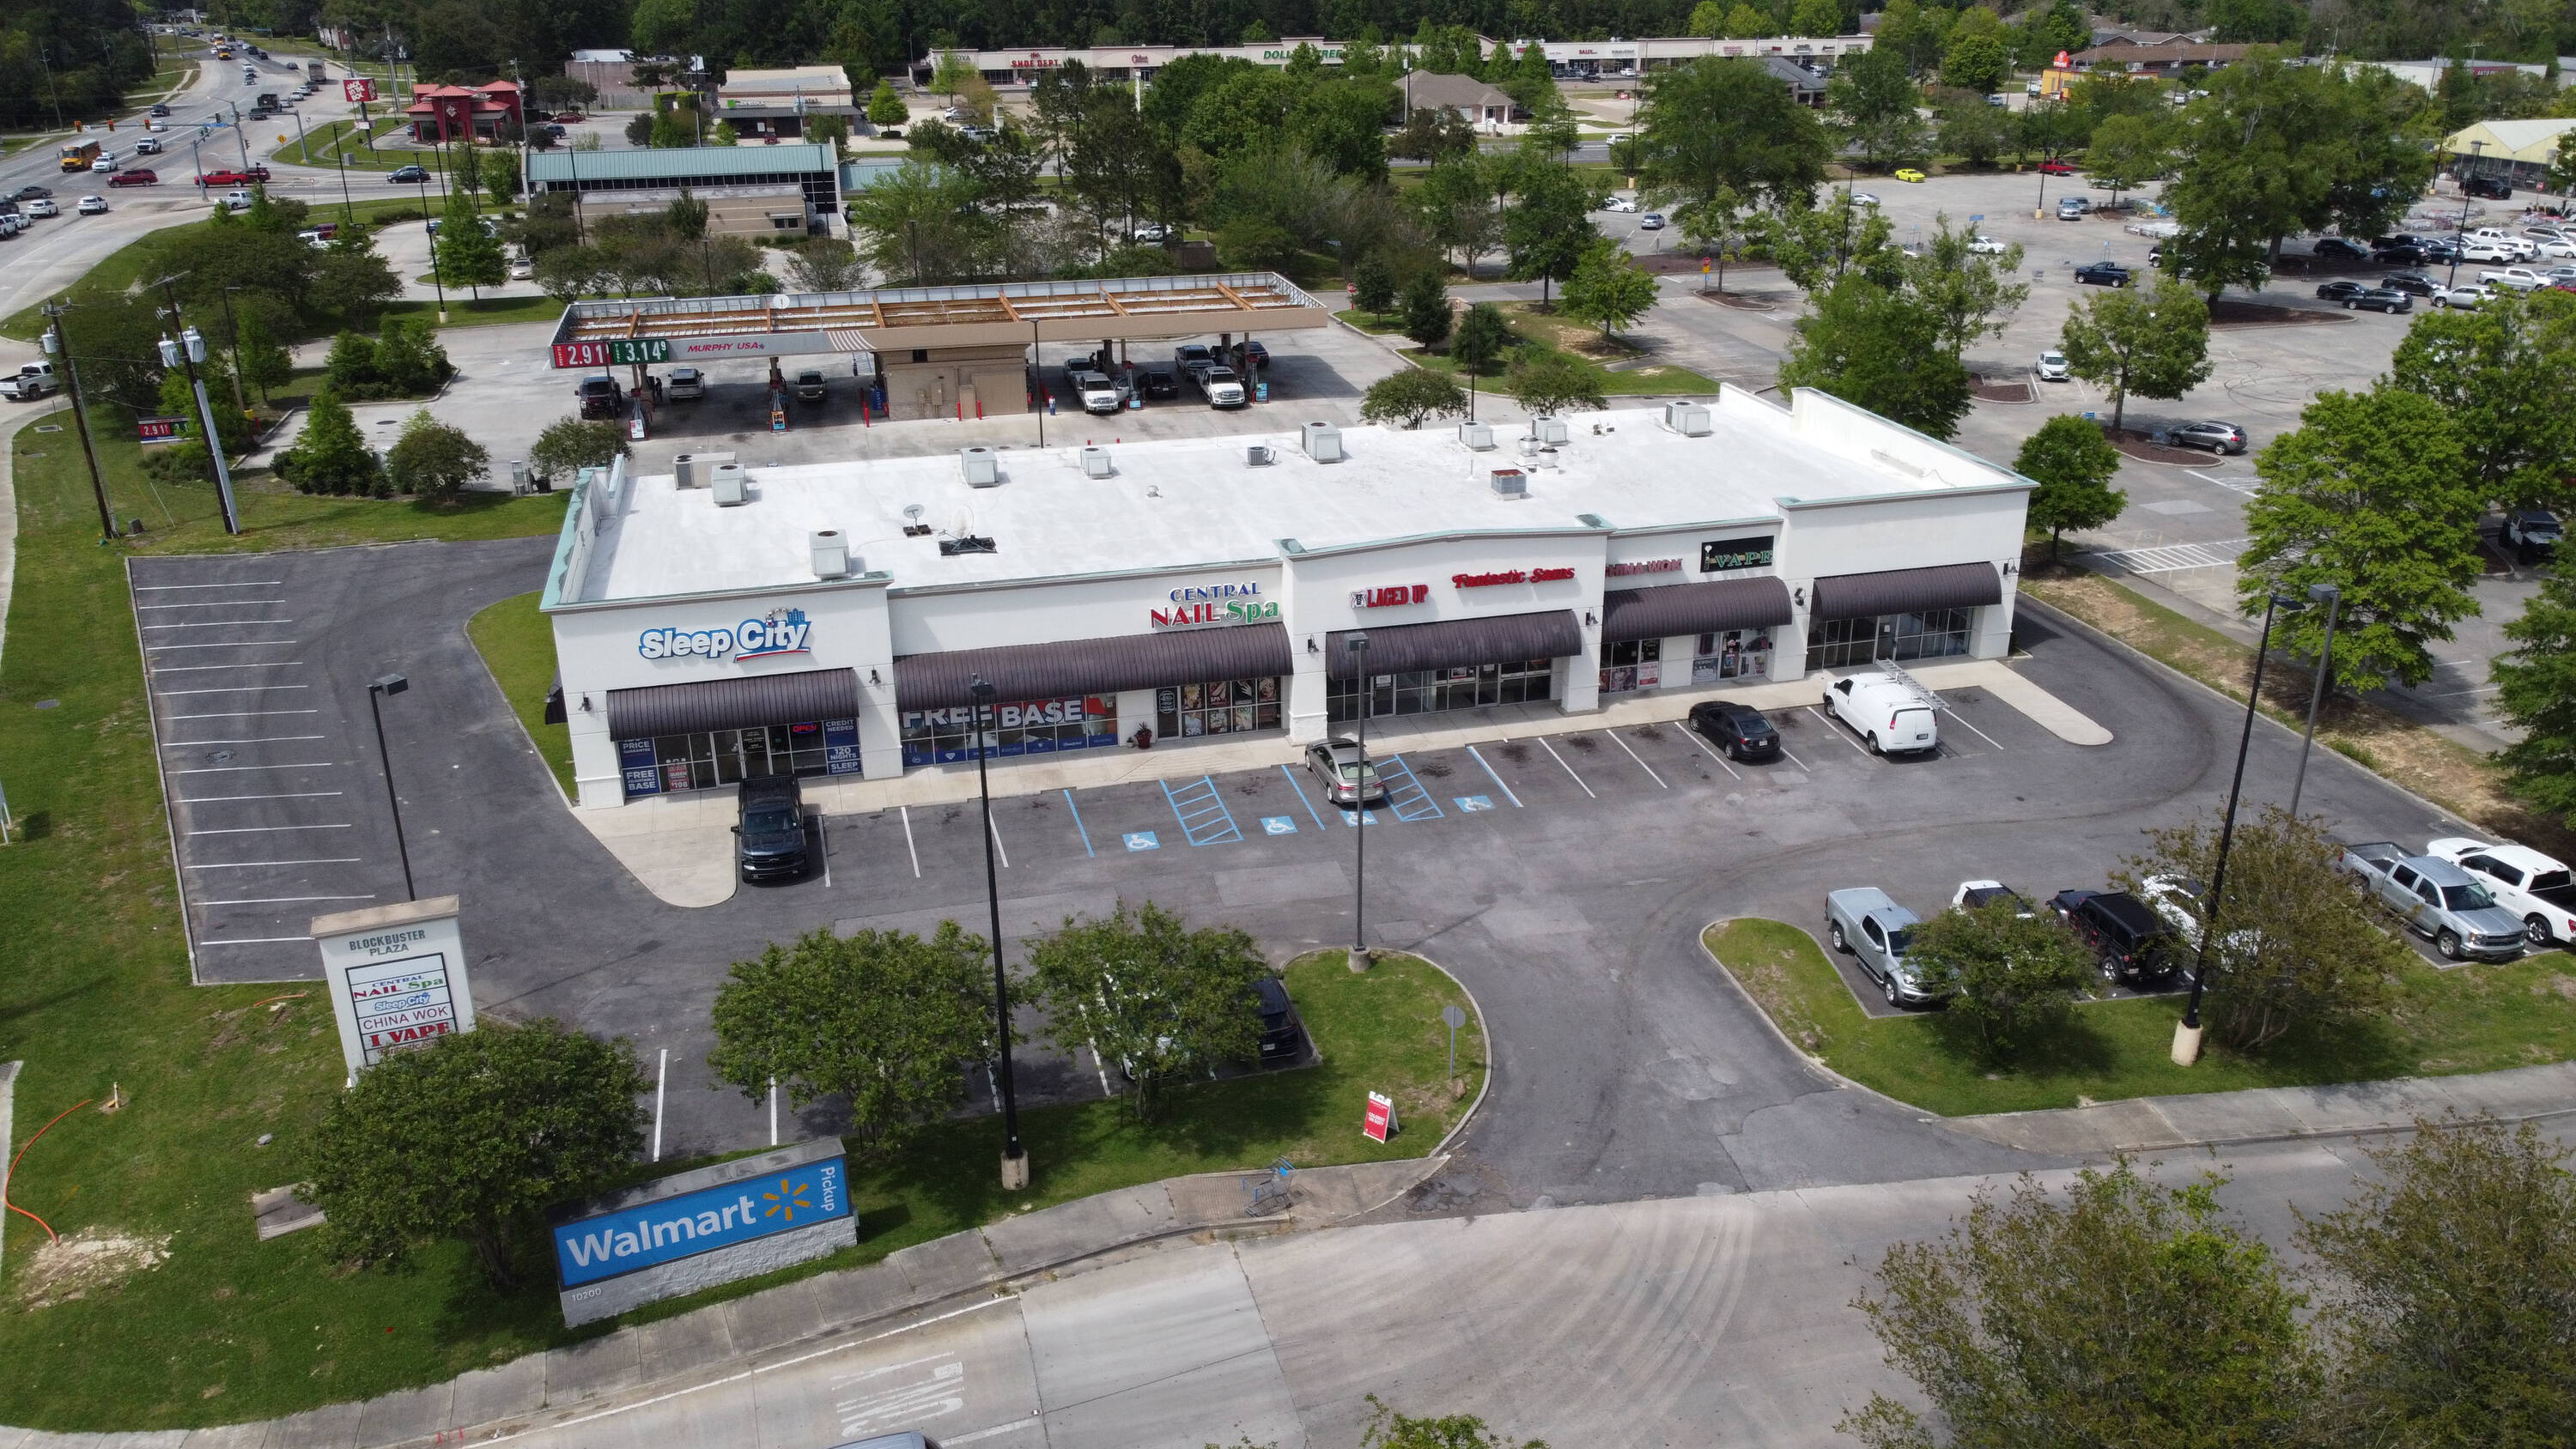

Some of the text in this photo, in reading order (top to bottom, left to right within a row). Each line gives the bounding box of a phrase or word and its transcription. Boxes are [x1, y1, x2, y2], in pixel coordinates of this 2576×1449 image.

[688, 342, 759, 353] MURPHY USA
[1647, 559, 1682, 573] WOK
[1451, 567, 1575, 589] Fantastic Sams
[1169, 580, 1262, 603] CENTRAL
[1366, 584, 1429, 608] LACED UP
[1150, 600, 1279, 629] NAIL Spa
[641, 618, 811, 659] Sleep City
[1001, 700, 1083, 728] BASE
[1186, 727, 1201, 737] SPA
[623, 741, 650, 749] PRICE
[834, 747, 852, 755] 120
[626, 770, 655, 779] FREE
[830, 761, 859, 770] SLEEP
[629, 781, 657, 791] BASE
[349, 930, 427, 951] BLOCKBUSTER
[369, 943, 410, 956] PLAZA
[353, 978, 444, 999] NAIL Spa
[372, 975, 425, 988] CENTRAL
[374, 991, 431, 1011] Sleep City
[363, 1006, 448, 1030] CHINA WOK
[387, 1022, 450, 1043] VAPE
[821, 1166, 835, 1212] Pickup
[567, 1196, 757, 1268] Walmart
[571, 1288, 602, 1301] 10200
